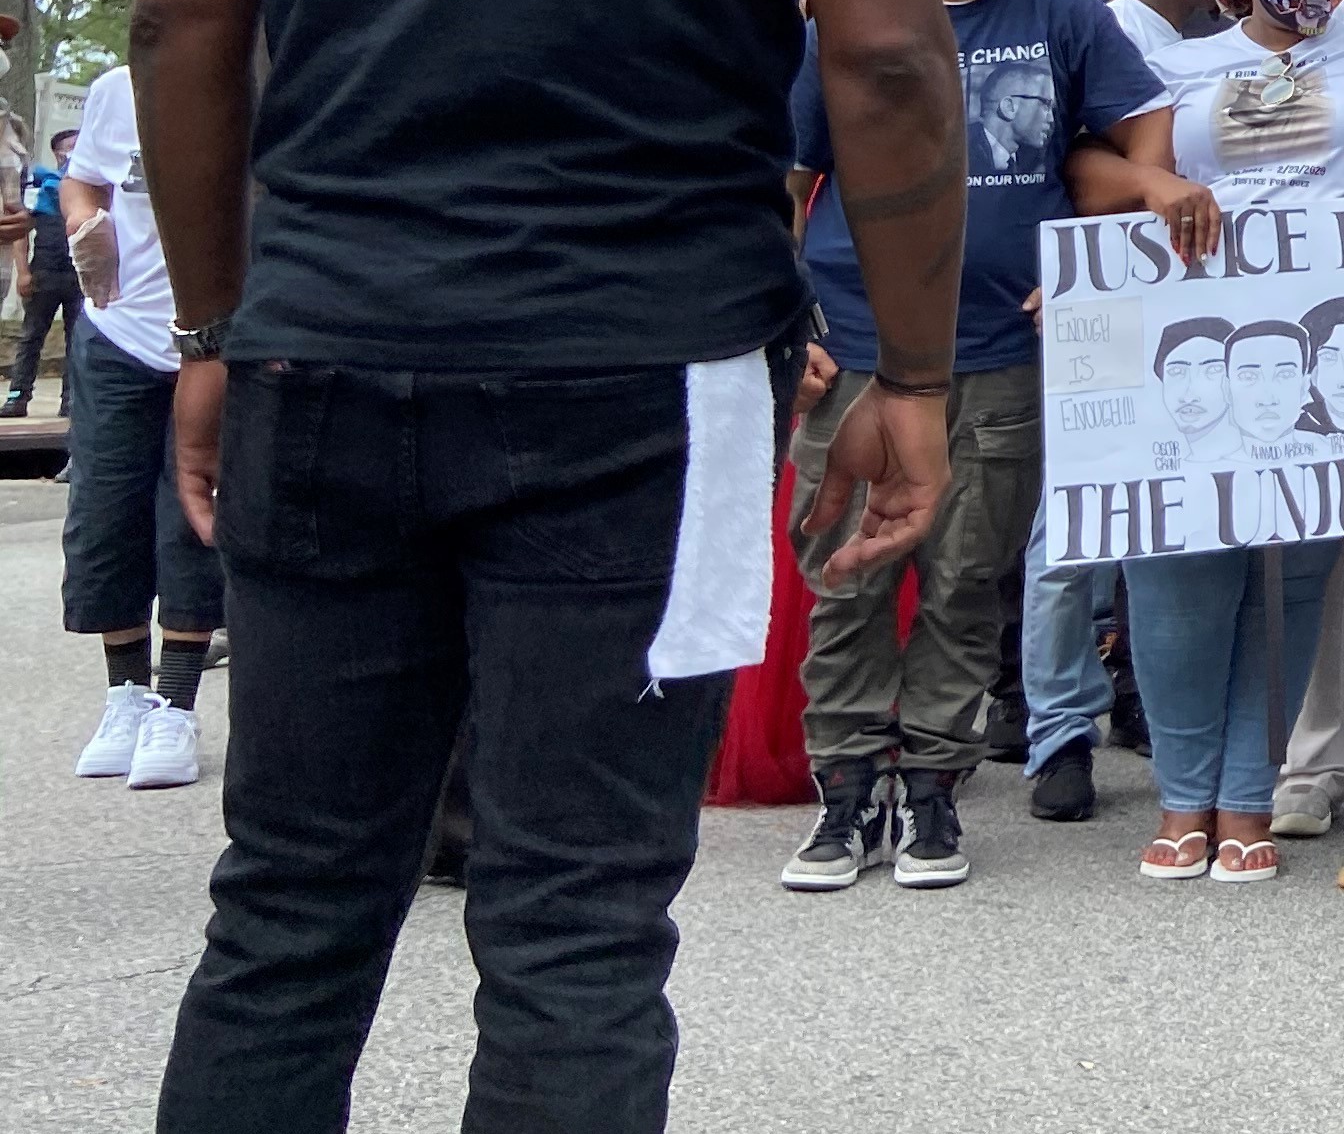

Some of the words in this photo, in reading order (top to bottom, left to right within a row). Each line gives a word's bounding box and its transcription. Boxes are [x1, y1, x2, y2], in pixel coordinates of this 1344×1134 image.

[985, 174, 1012, 186] OUR
[1015, 173, 1046, 185] YOUTH
[1069, 354, 1095, 385] IS
[1053, 475, 1187, 563] THE
